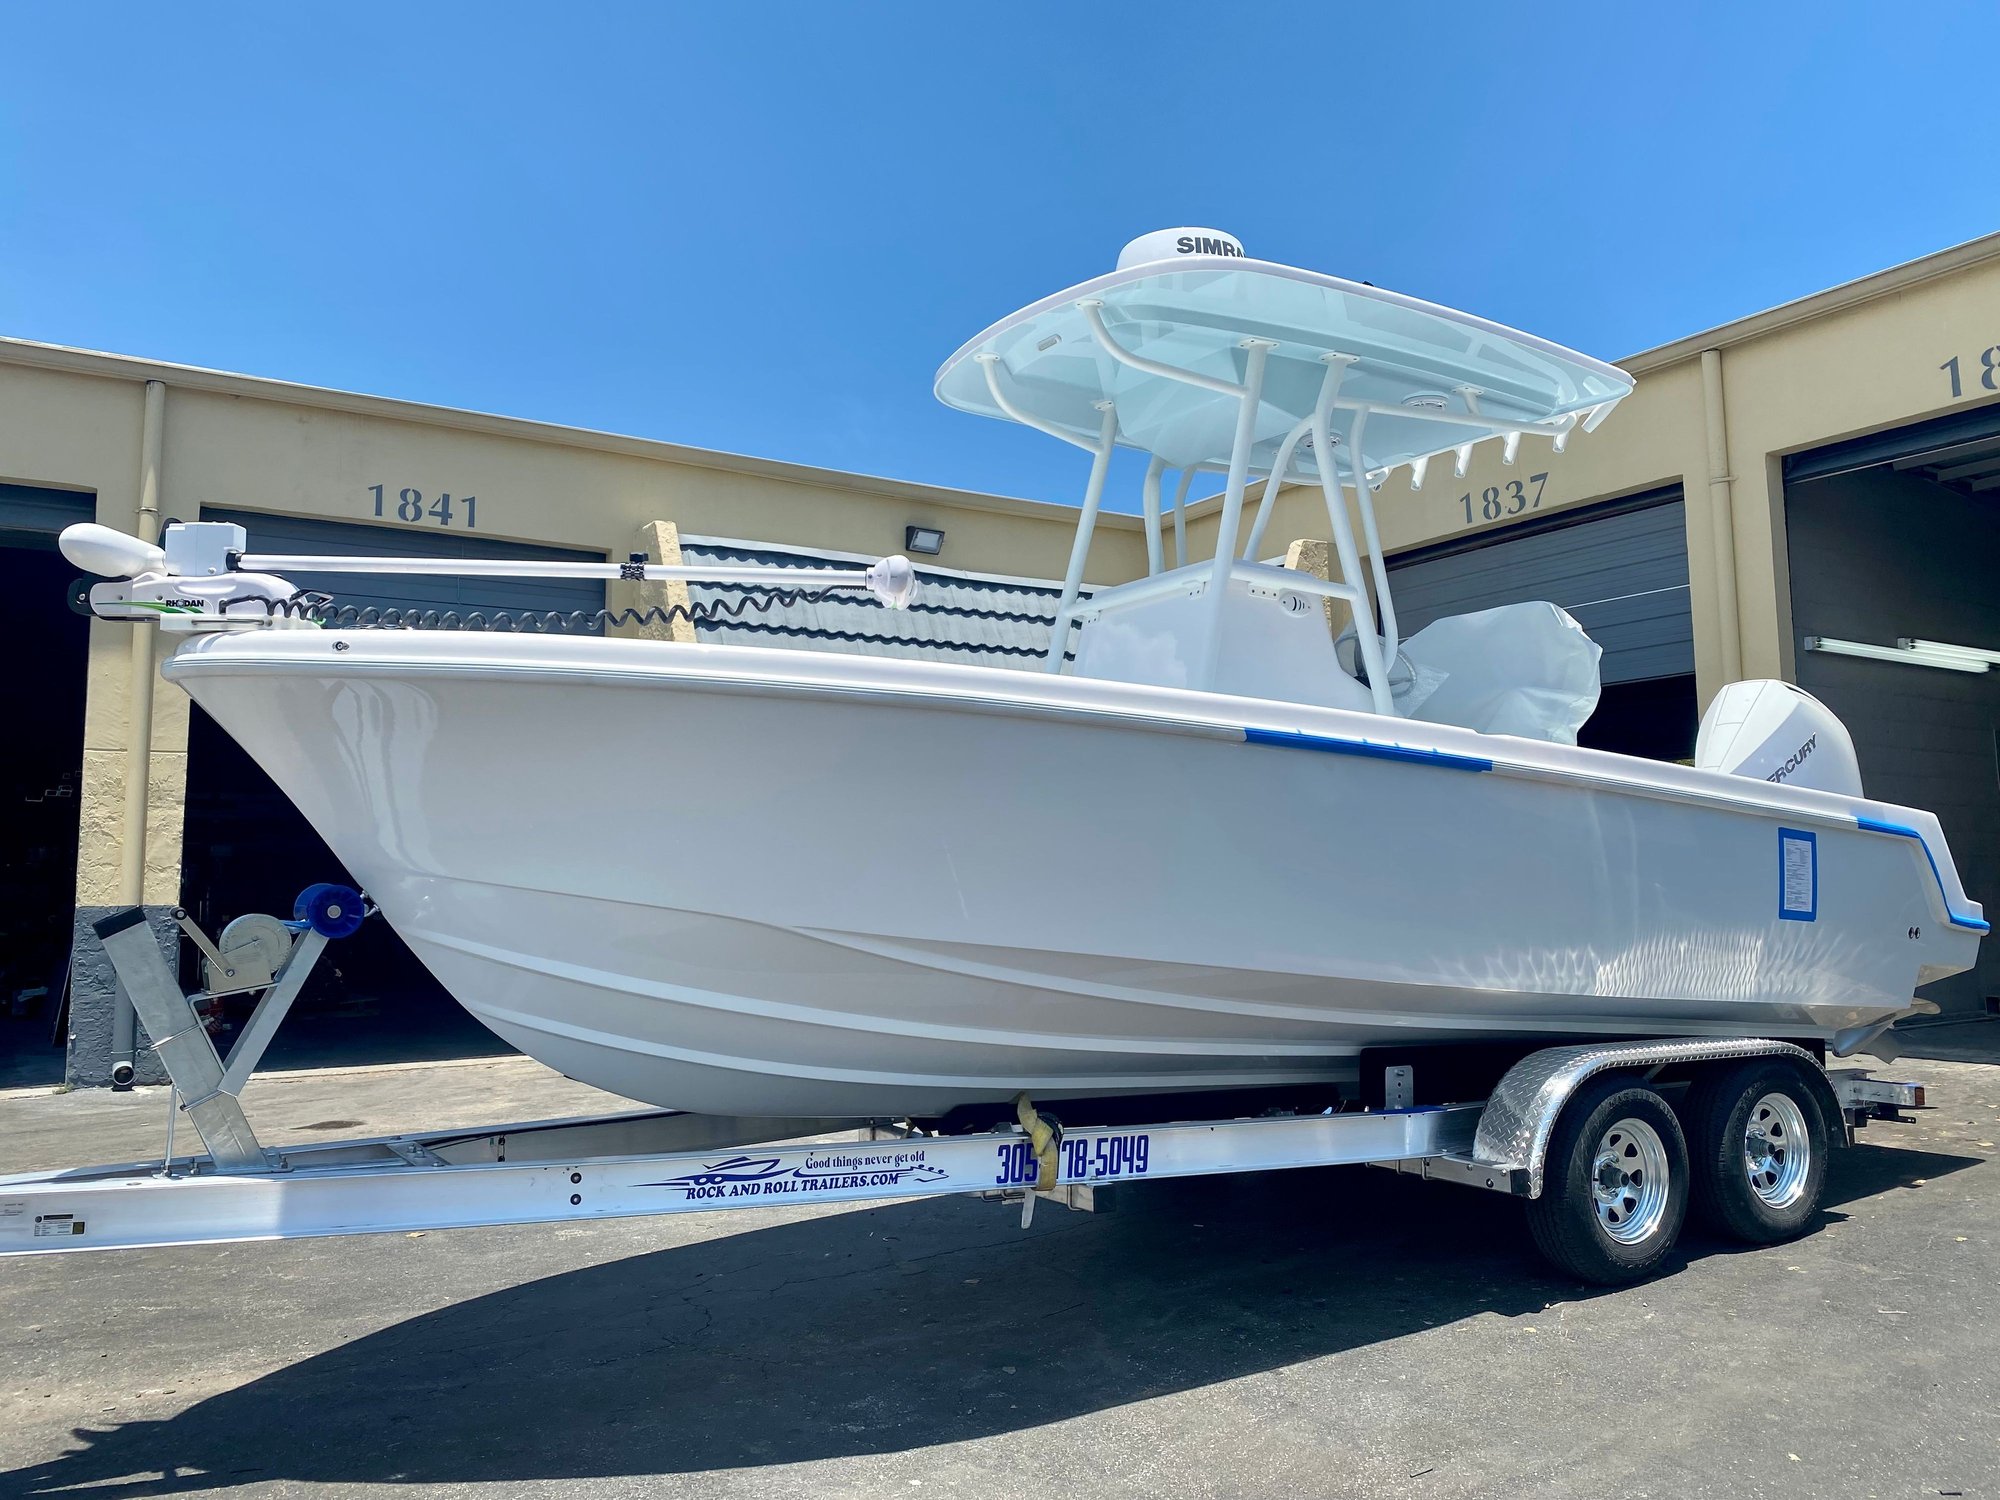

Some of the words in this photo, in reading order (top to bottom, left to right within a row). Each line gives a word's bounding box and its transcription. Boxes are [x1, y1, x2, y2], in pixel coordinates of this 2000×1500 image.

[1177, 237, 1246, 258] SIMRA
[368, 484, 476, 528] 1841
[1460, 472, 1549, 524] 1837
[1766, 733, 1816, 783] ERCURY
[806, 1157, 830, 1169] Good
[833, 1156, 863, 1170] things
[865, 1155, 892, 1165] never
[894, 1153, 908, 1167] get
[910, 1150, 925, 1161] old
[686, 1185, 726, 1200] ROCK
[729, 1182, 760, 1197] AND
[763, 1180, 799, 1194] ROLL
[801, 1174, 898, 1191] TRAILERS.COM
